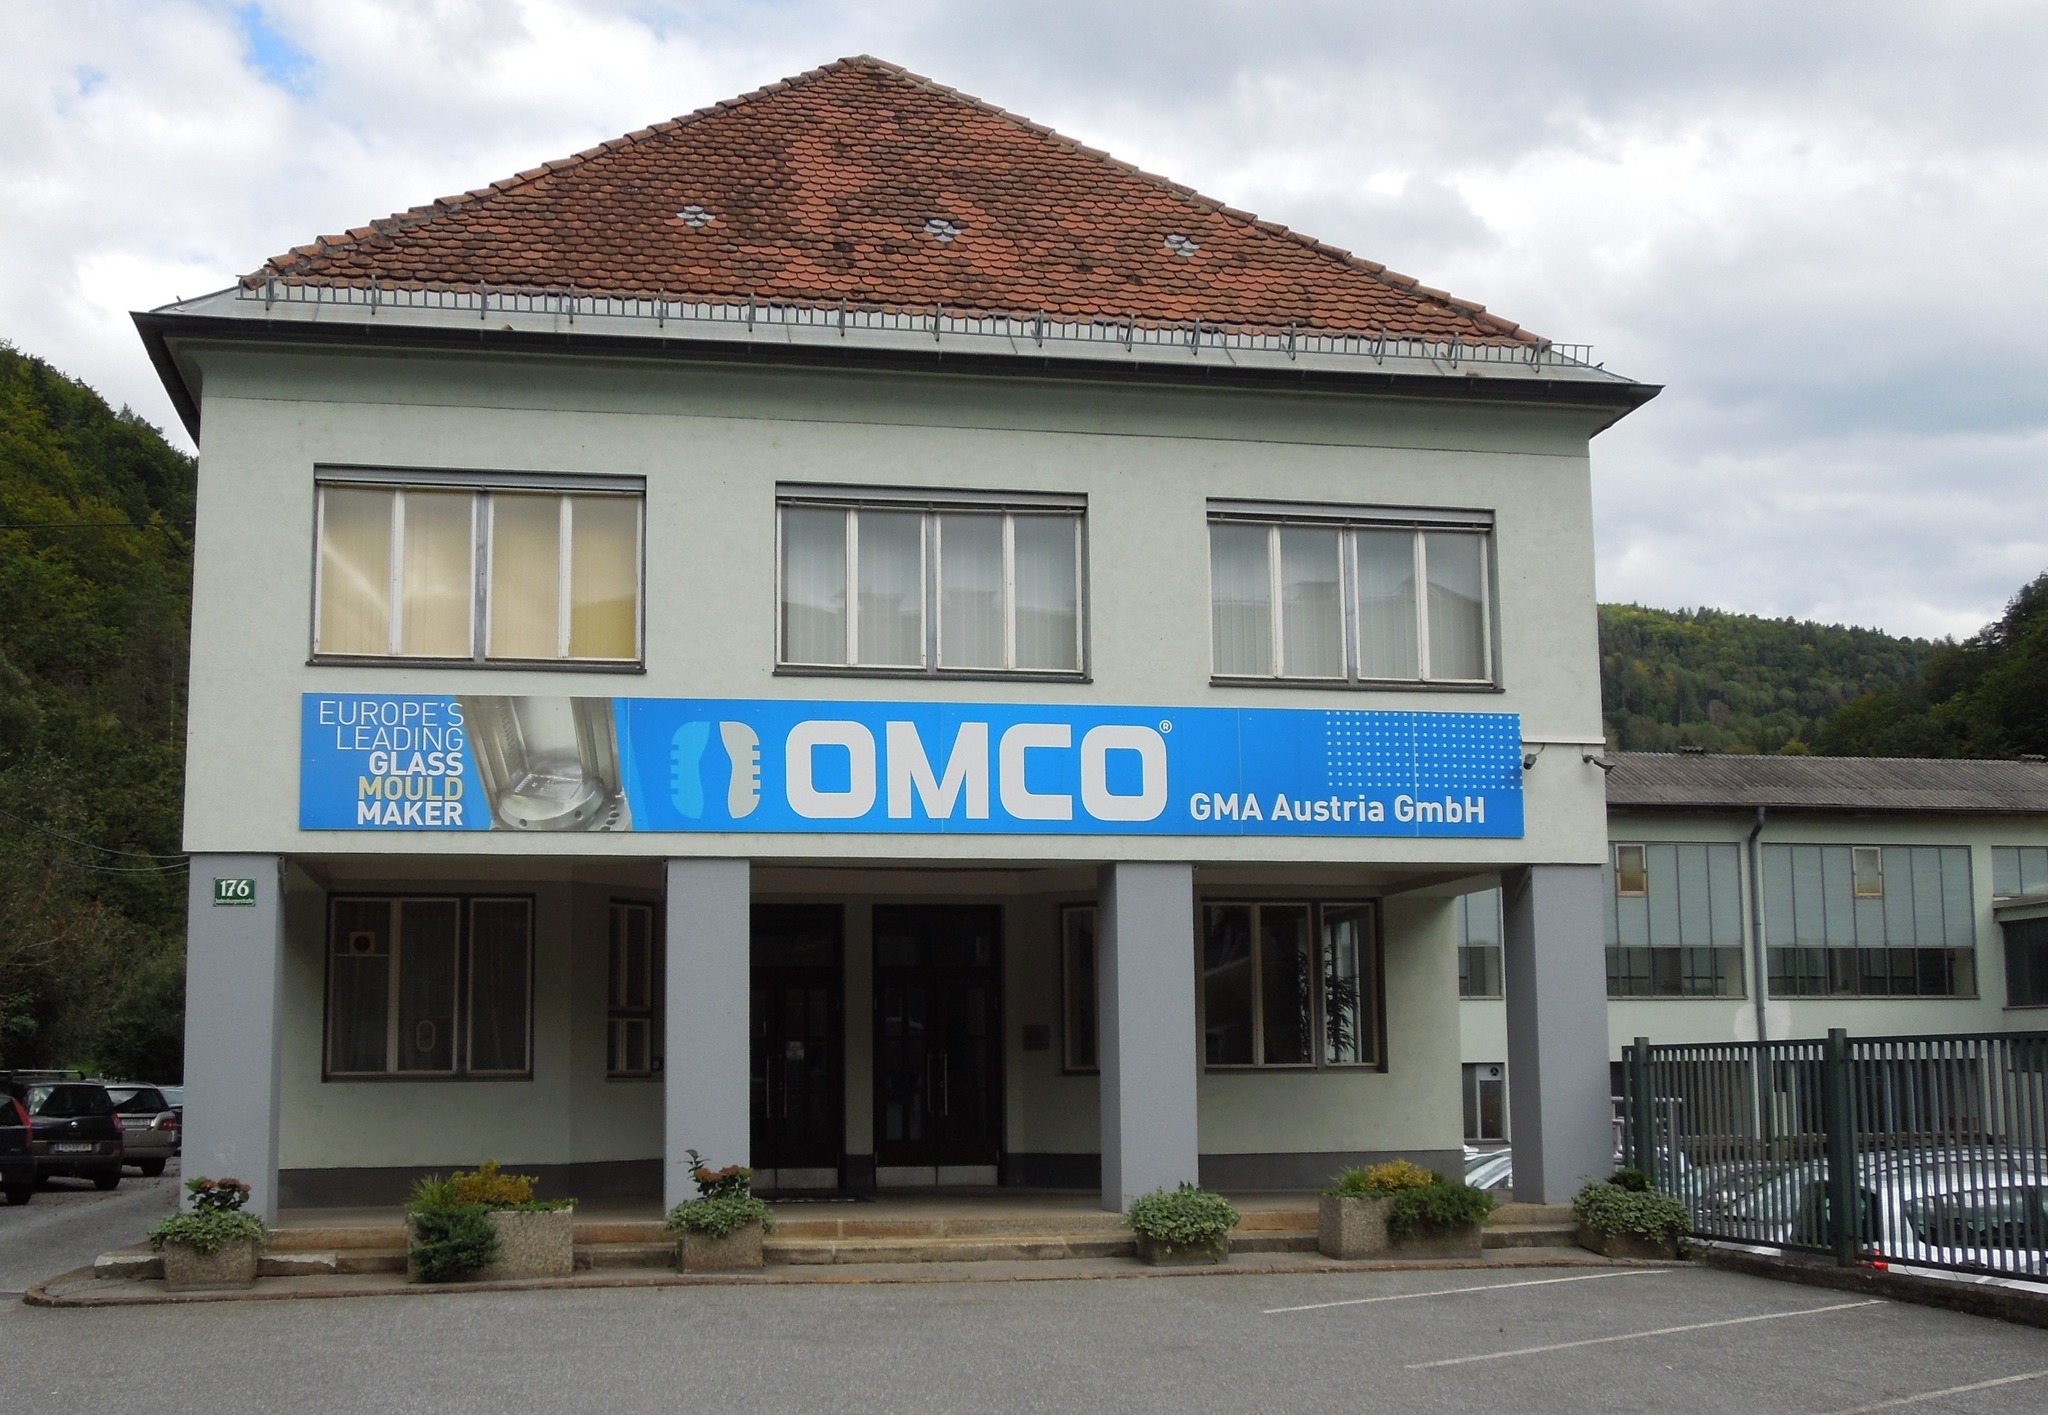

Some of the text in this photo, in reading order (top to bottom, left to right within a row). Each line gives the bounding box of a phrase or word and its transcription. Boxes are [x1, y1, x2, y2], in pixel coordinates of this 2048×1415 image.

[319, 700, 464, 726] EUROPE'S
[336, 726, 463, 751] LEADING
[368, 751, 464, 776] GLASS
[785, 720, 1168, 822] OMCO
[358, 775, 463, 801] MOULD
[356, 800, 463, 826] MAKER
[1190, 792, 1486, 824] GMA Austria GmbH
[220, 880, 249, 897] 176
